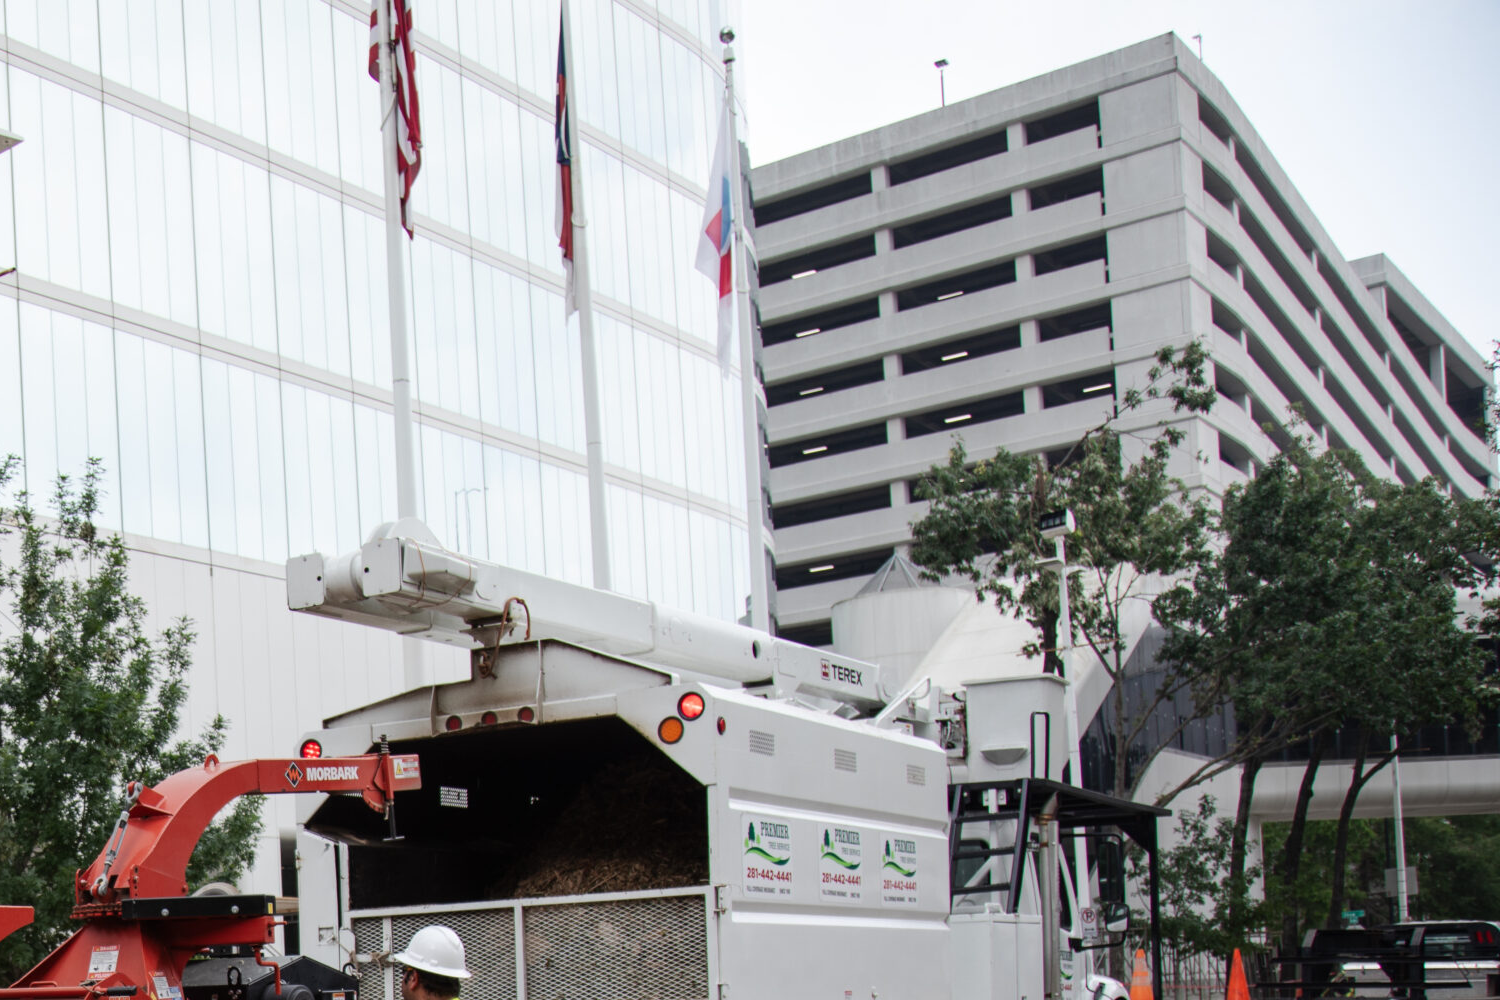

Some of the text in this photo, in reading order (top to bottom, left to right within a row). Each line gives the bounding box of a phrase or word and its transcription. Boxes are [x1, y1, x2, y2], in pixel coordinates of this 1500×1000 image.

[832, 664, 863, 686] TEREX
[306, 766, 359, 782] MORBARK
[760, 822, 789, 839] PREMIER
[834, 828, 860, 845] PREMIER
[894, 839, 916, 854] PREMIER
[747, 867, 792, 882] 281-442-4441
[822, 872, 861, 886] 281-442-4441
[883, 879, 916, 891] 281-442-4441
